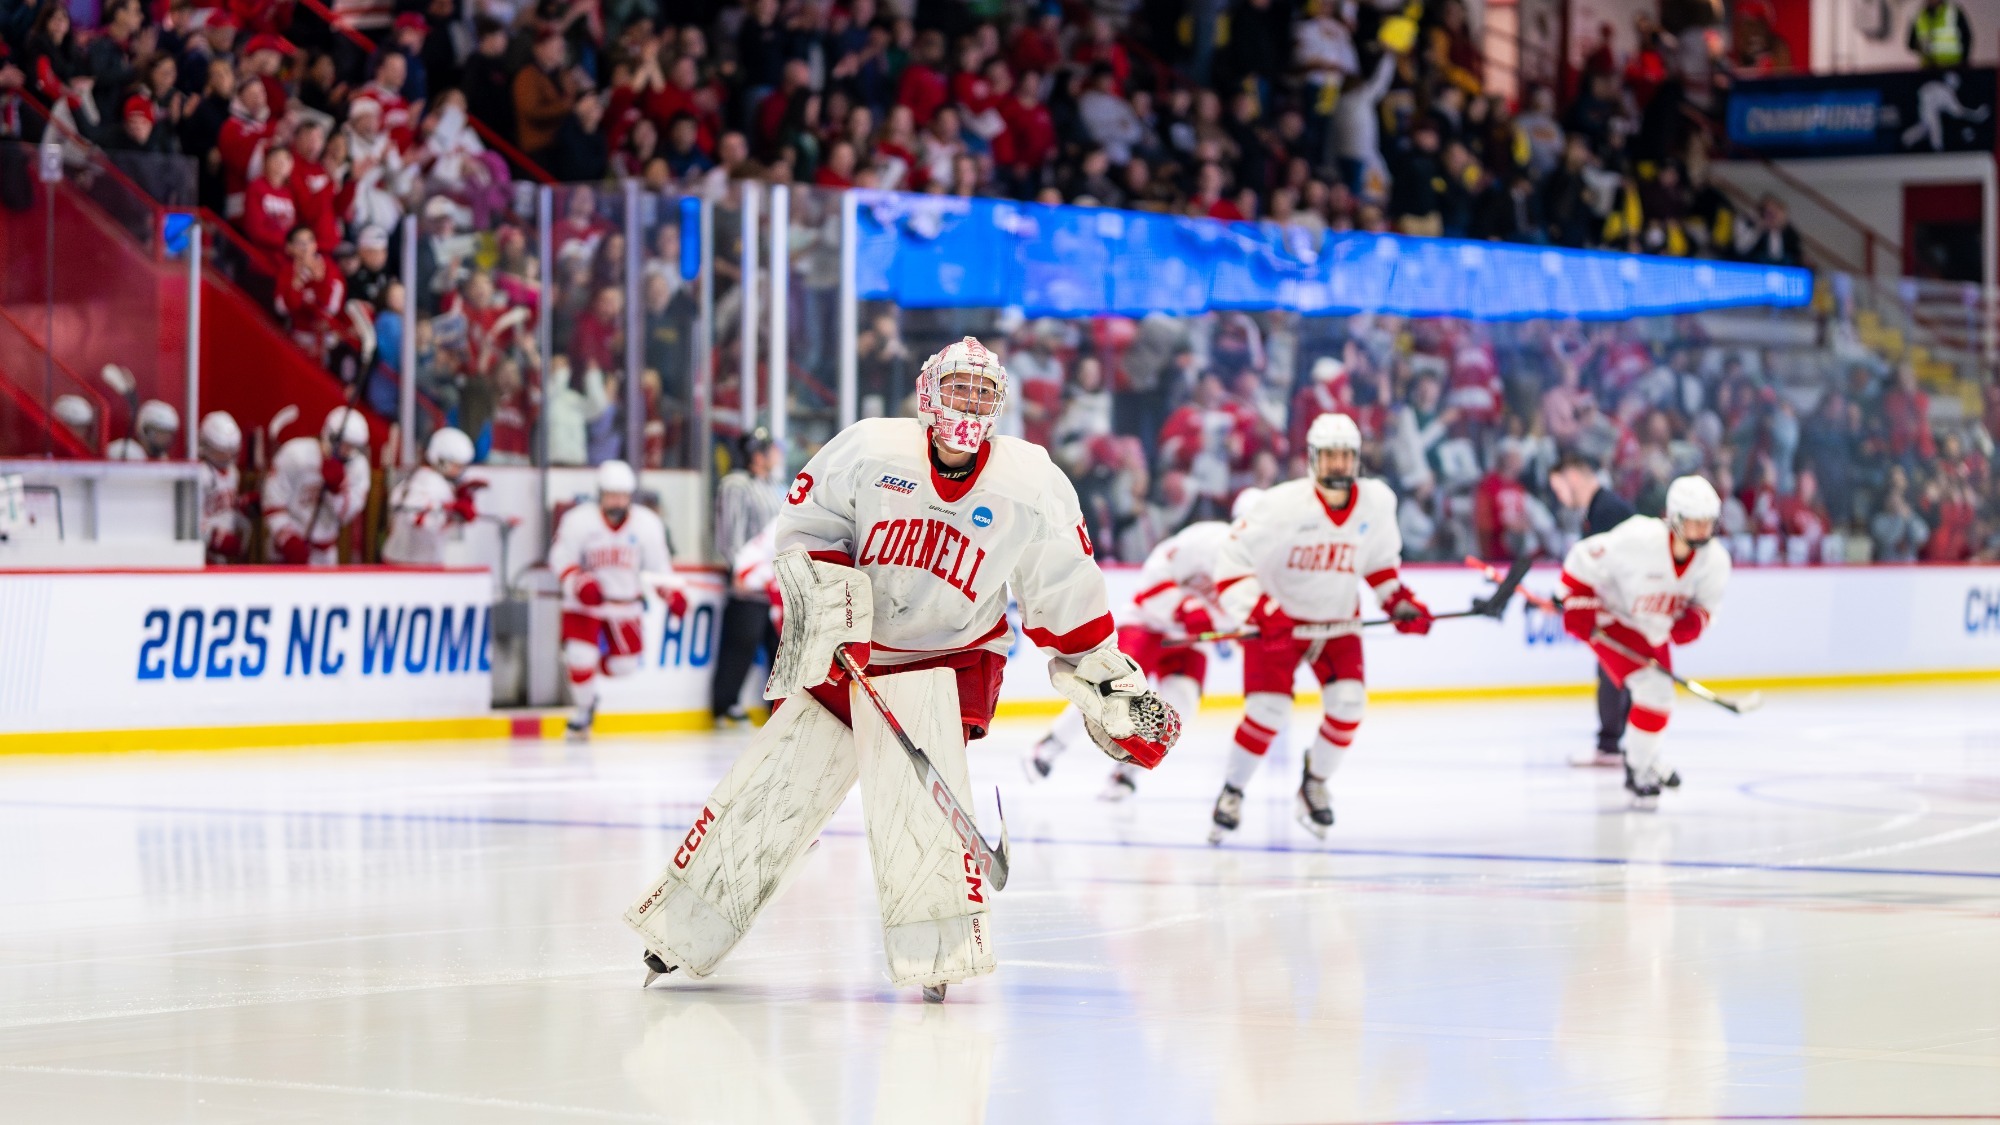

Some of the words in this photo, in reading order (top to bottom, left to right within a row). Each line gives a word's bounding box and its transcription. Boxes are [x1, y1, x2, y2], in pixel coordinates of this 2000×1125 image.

[954, 419, 982, 448] 43
[785, 471, 814, 505] 3
[881, 475, 917, 490] ECAC
[882, 483, 912, 495] HOCKEY
[973, 514, 991, 525] NCAA
[858, 518, 986, 603] CORNELL
[137, 608, 271, 680] 2025
[285, 607, 349, 676] NC
[673, 806, 716, 869] CCM
[932, 780, 993, 877] CCM
[962, 842, 983, 903] CM
[652, 886, 664, 900] XF
